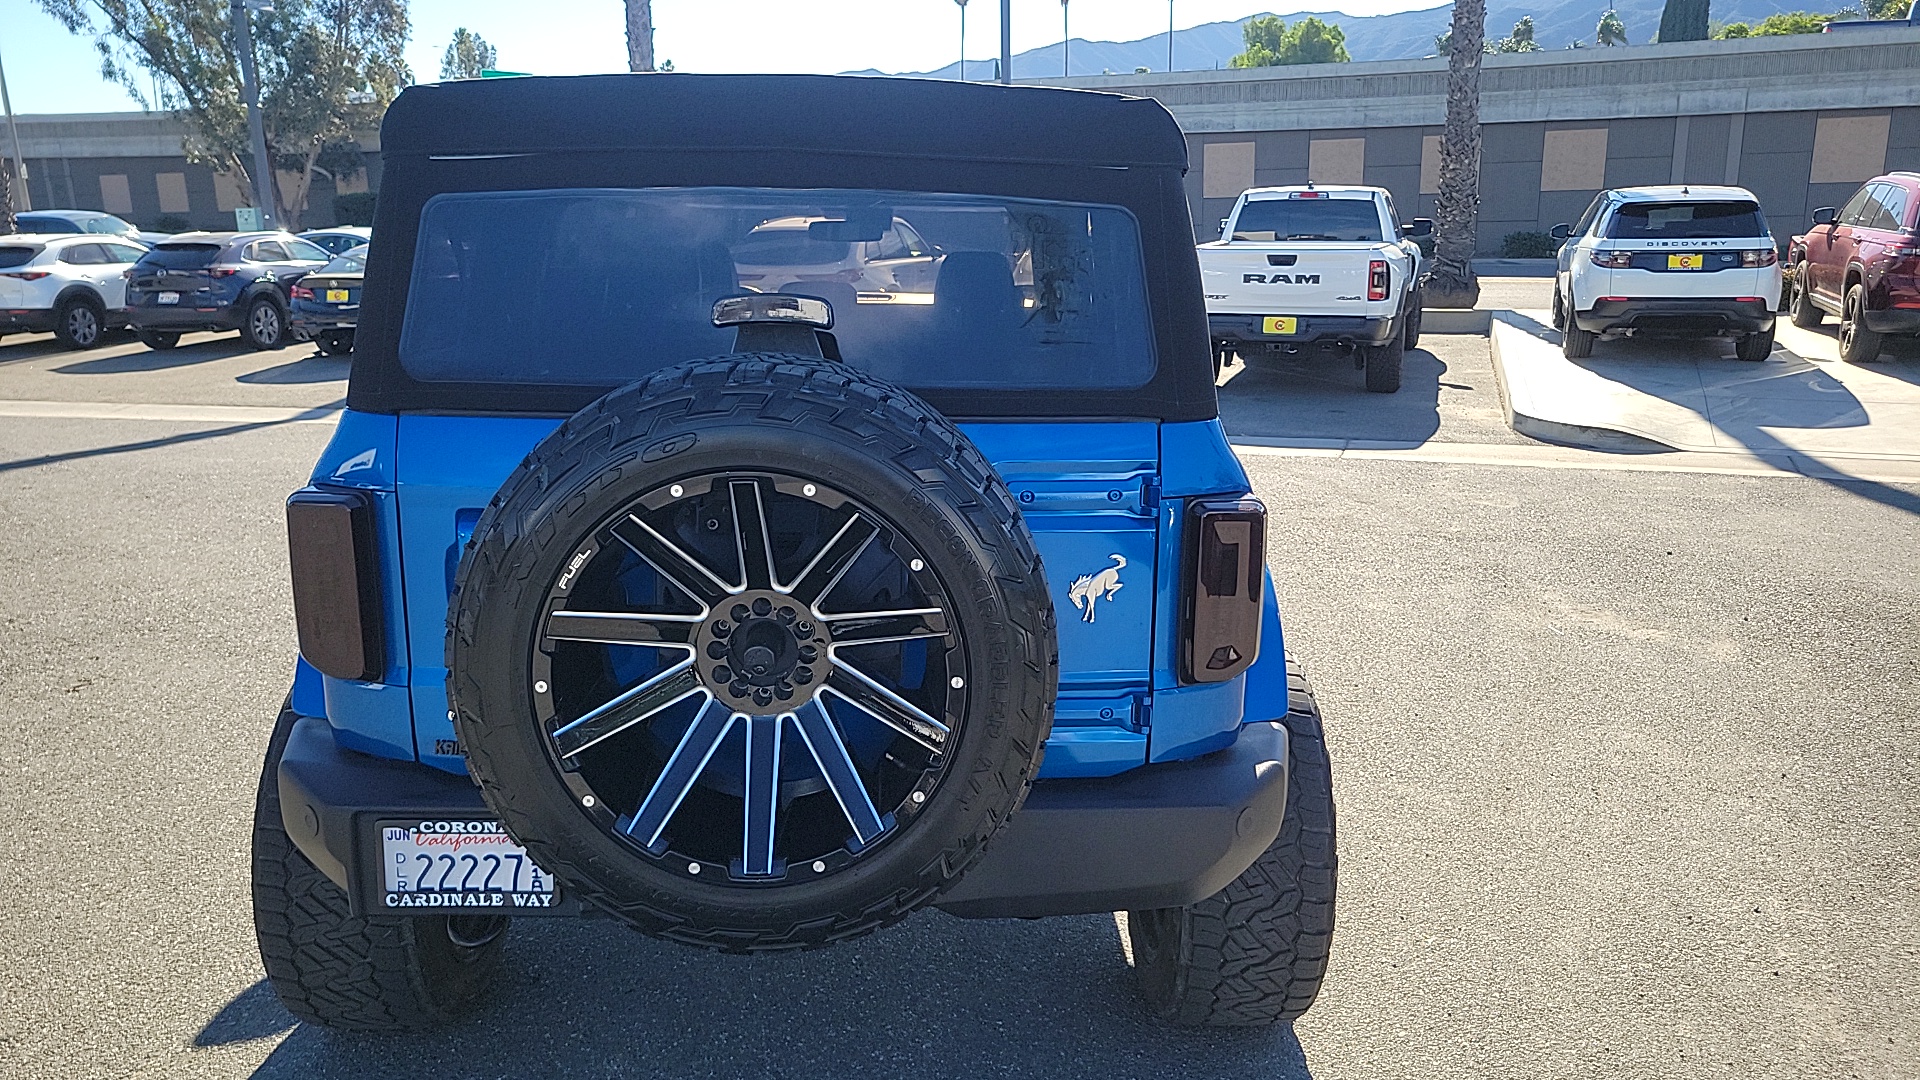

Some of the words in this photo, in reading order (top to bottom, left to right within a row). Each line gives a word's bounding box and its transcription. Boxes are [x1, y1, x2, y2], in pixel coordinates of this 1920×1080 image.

[1242, 274, 1321, 285] RAM
[504, 432, 697, 609] NITTO
[900, 486, 980, 576] RECON
[558, 549, 592, 590] FUEL
[387, 829, 410, 841] JUN
[415, 853, 523, 891] 22227
[385, 893, 504, 907] CARDINALE
[512, 893, 553, 907] WAY
